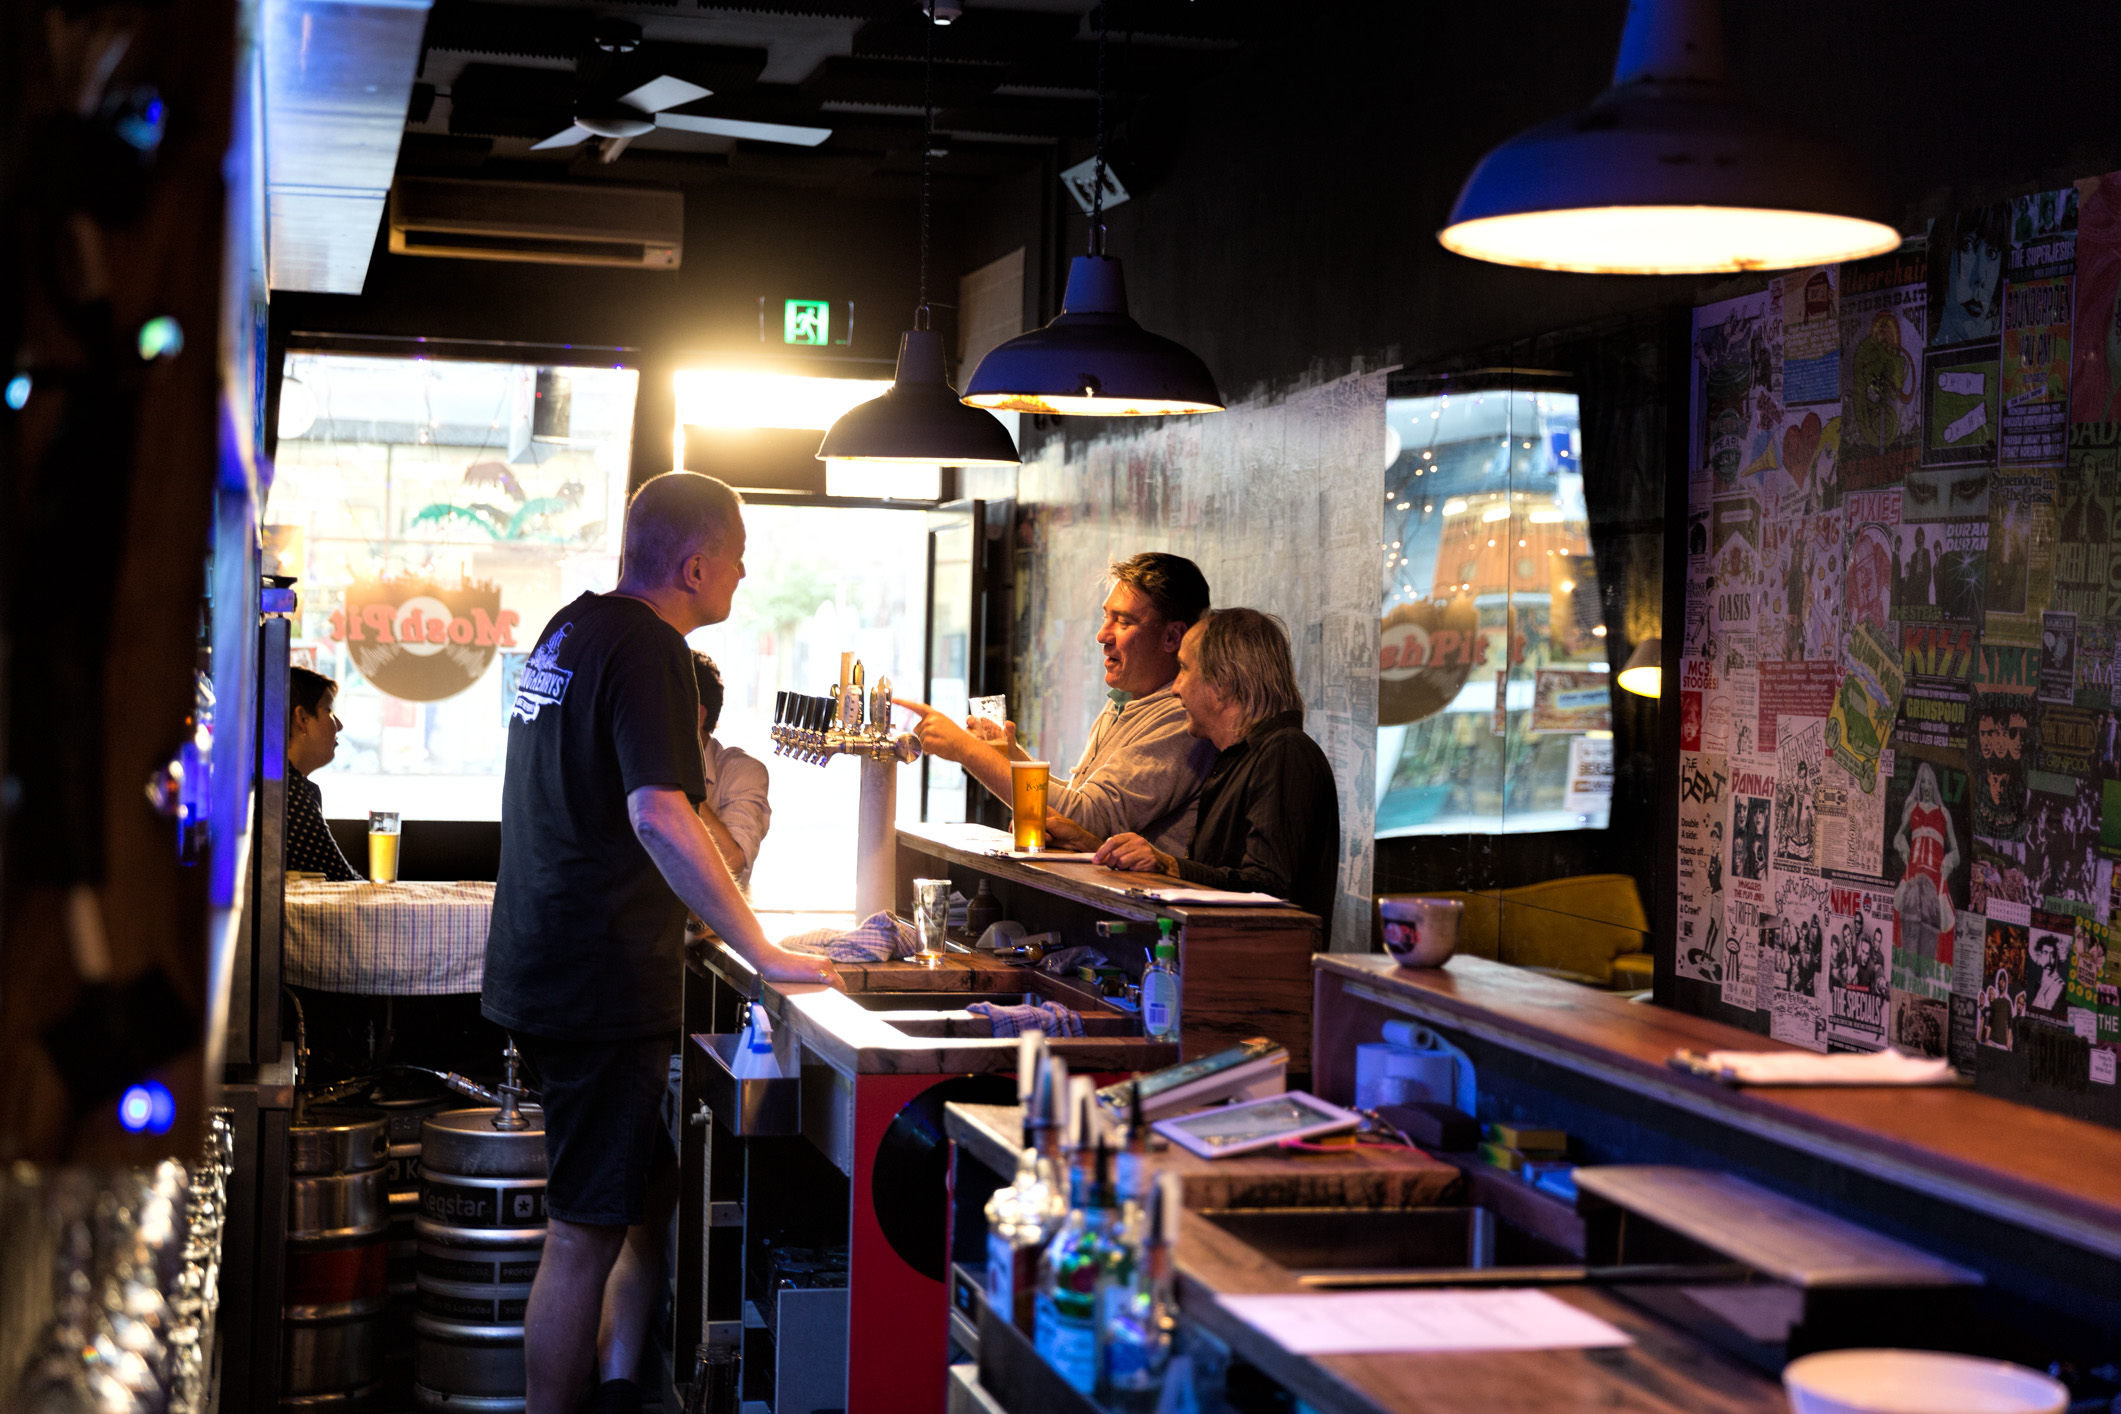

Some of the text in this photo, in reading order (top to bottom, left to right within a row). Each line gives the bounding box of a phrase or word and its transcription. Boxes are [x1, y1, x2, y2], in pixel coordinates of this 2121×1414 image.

[2010, 240, 2076, 270] THE SUPERJESUS
[2005, 283, 2073, 331] SOUNDGARDEN
[1714, 437, 1742, 452] PEARL
[1991, 470, 2043, 490] Splendour
[1849, 493, 1901, 526] PIXIES
[2004, 488, 2053, 510] the Grass
[1946, 522, 1989, 537] DURAN
[1946, 536, 1988, 551] DURAN
[1718, 593, 1751, 622] OASIS
[1380, 630, 1489, 670] shPit
[1903, 626, 1973, 679] KISS
[1683, 675, 1719, 690] STOOGES!
[1906, 698, 1966, 723] GRINSPOON
[1978, 692, 2030, 712] SPIDERS
[1685, 756, 1698, 771] THE
[1731, 773, 1776, 798] DONNAS
[1942, 771, 1967, 804] L7
[1681, 817, 1699, 829] Double
[1680, 857, 1693, 867] she's
[1734, 900, 1760, 928] TRIFFIDS
[1830, 888, 1862, 917] NME
[2078, 966, 2096, 980] STONE
[2082, 959, 2093, 970] THE
[1833, 987, 1846, 1016] THE
[1847, 991, 1881, 1024] SPECIALS
[2098, 1013, 2119, 1032] THE
[423, 1187, 487, 1220] Kegstar
